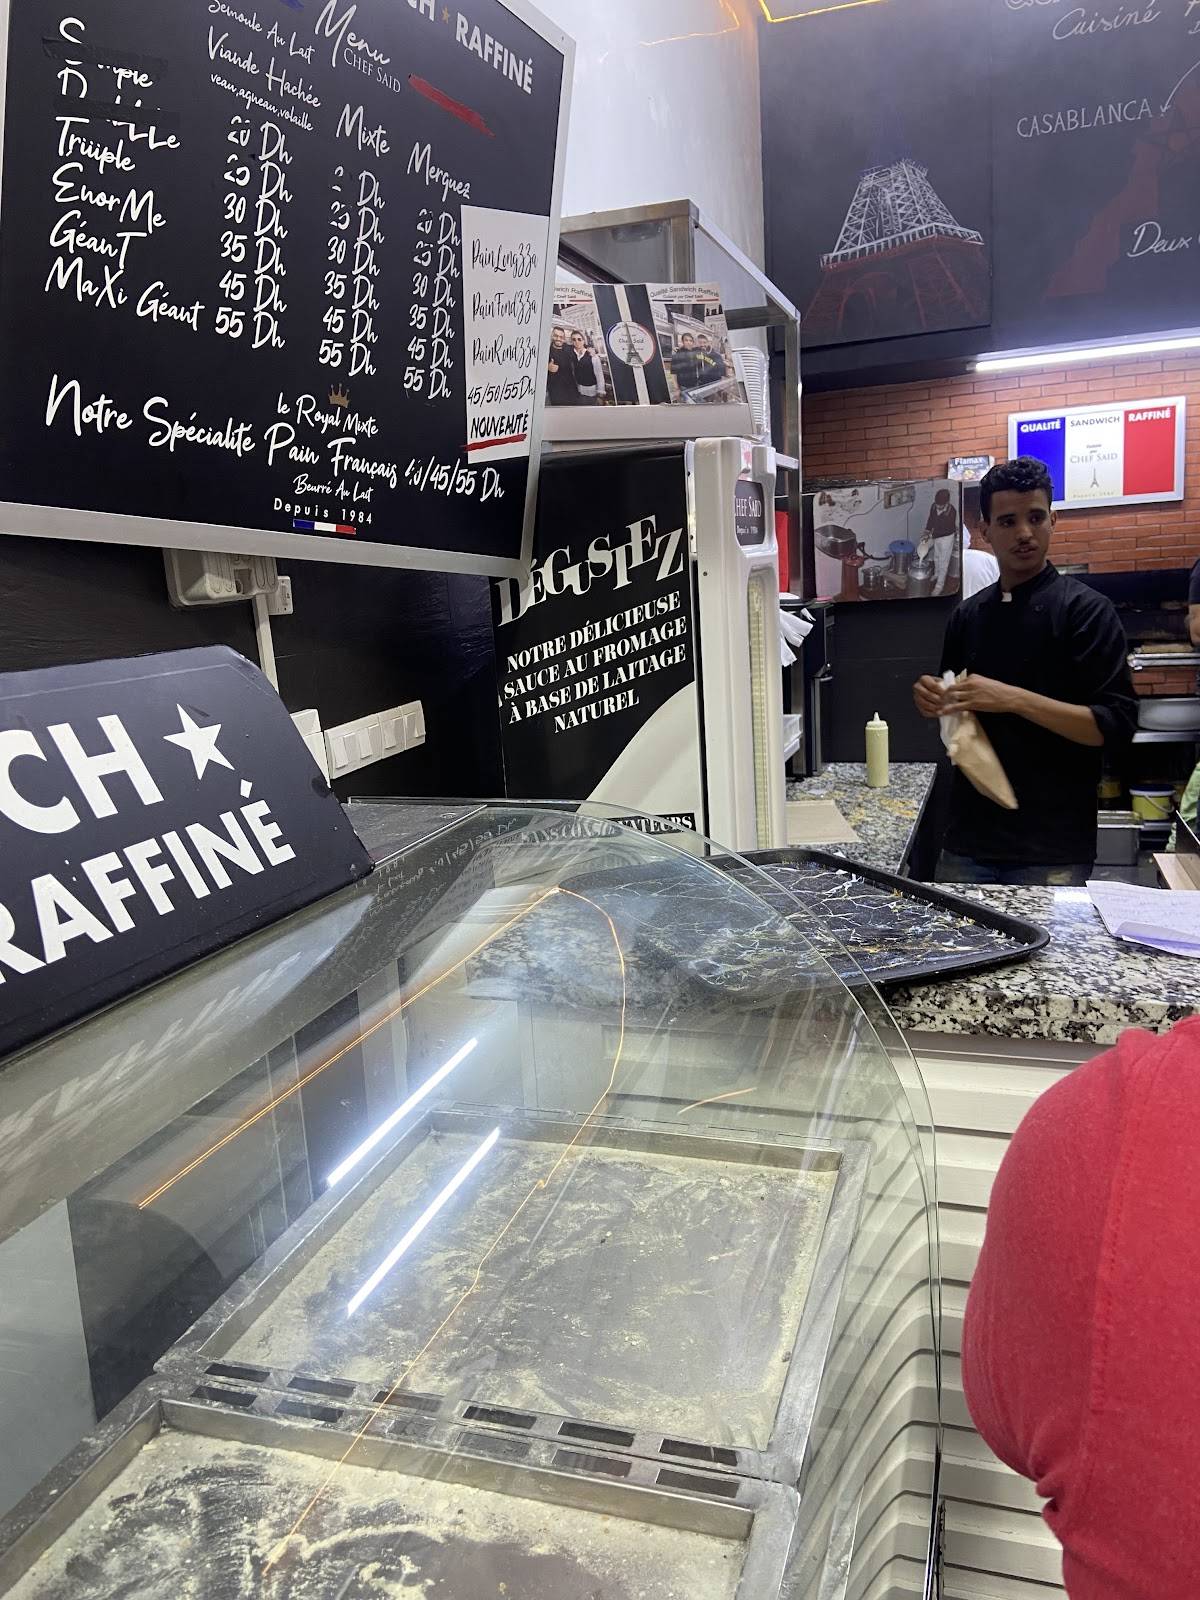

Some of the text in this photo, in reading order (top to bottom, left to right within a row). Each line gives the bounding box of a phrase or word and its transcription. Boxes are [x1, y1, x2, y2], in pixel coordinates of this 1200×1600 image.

[208, 0, 316, 65] Semoule Au Lait
[314, 0, 391, 67] Menu
[1053, 4, 1161, 40] Cuisiné
[208, 26, 321, 108] Viande Hachée
[343, 47, 402, 94] CHEF SAID
[456, 12, 533, 95] RAFFINÉ
[336, 103, 391, 157] Mixte
[1017, 98, 1153, 138] CASABLANCA
[259, 121, 293, 164] Dh
[259, 160, 293, 203] Dh
[356, 170, 386, 208] Dh
[407, 141, 472, 202] Merguez
[52, 162, 166, 234] EnorMe
[223, 193, 288, 239] 30 Dh
[49, 209, 148, 270] GéanT
[356, 206, 385, 244] Dh
[437, 212, 461, 246] Dh
[1127, 221, 1193, 257] Deux
[220, 231, 287, 277] 35 Dh
[327, 236, 380, 277] 30 Dh
[436, 244, 461, 279] Dh
[44, 257, 206, 331] MaXi Géant
[218, 270, 287, 313] 45 Dh
[324, 271, 381, 310] 35 Dh
[412, 272, 456, 309] 30 Dh
[215, 307, 286, 349] 55 Dh
[322, 306, 379, 344] 45 Dh
[409, 304, 455, 340] 35 Dh
[318, 339, 377, 377] 55 Dh
[407, 335, 454, 370] 45 Dh
[403, 366, 452, 400] 55 Dh
[46, 374, 256, 458] Notre Spécialité
[277, 392, 379, 438] le Royal Mixte
[470, 409, 529, 439] NOUVEAUTÉ
[1020, 407, 1172, 433] QUALITÉ SANDWICH RAFFINÉ
[263, 422, 320, 467] Pain
[327, 437, 398, 490] Français
[480, 467, 506, 503] Dh
[1097, 452, 1118, 463] SAID
[293, 473, 374, 503] Beurré Au Lait
[274, 497, 374, 525] Depuis 1984
[495, 514, 684, 627] DÉGUSTEZ
[506, 590, 682, 674] NOTRE DÉLICIEUSE
[503, 615, 688, 701] SAUCE AU FROMAGE
[508, 643, 687, 725] À BASE DE LAITAGE
[553, 688, 640, 734] NATUREL
